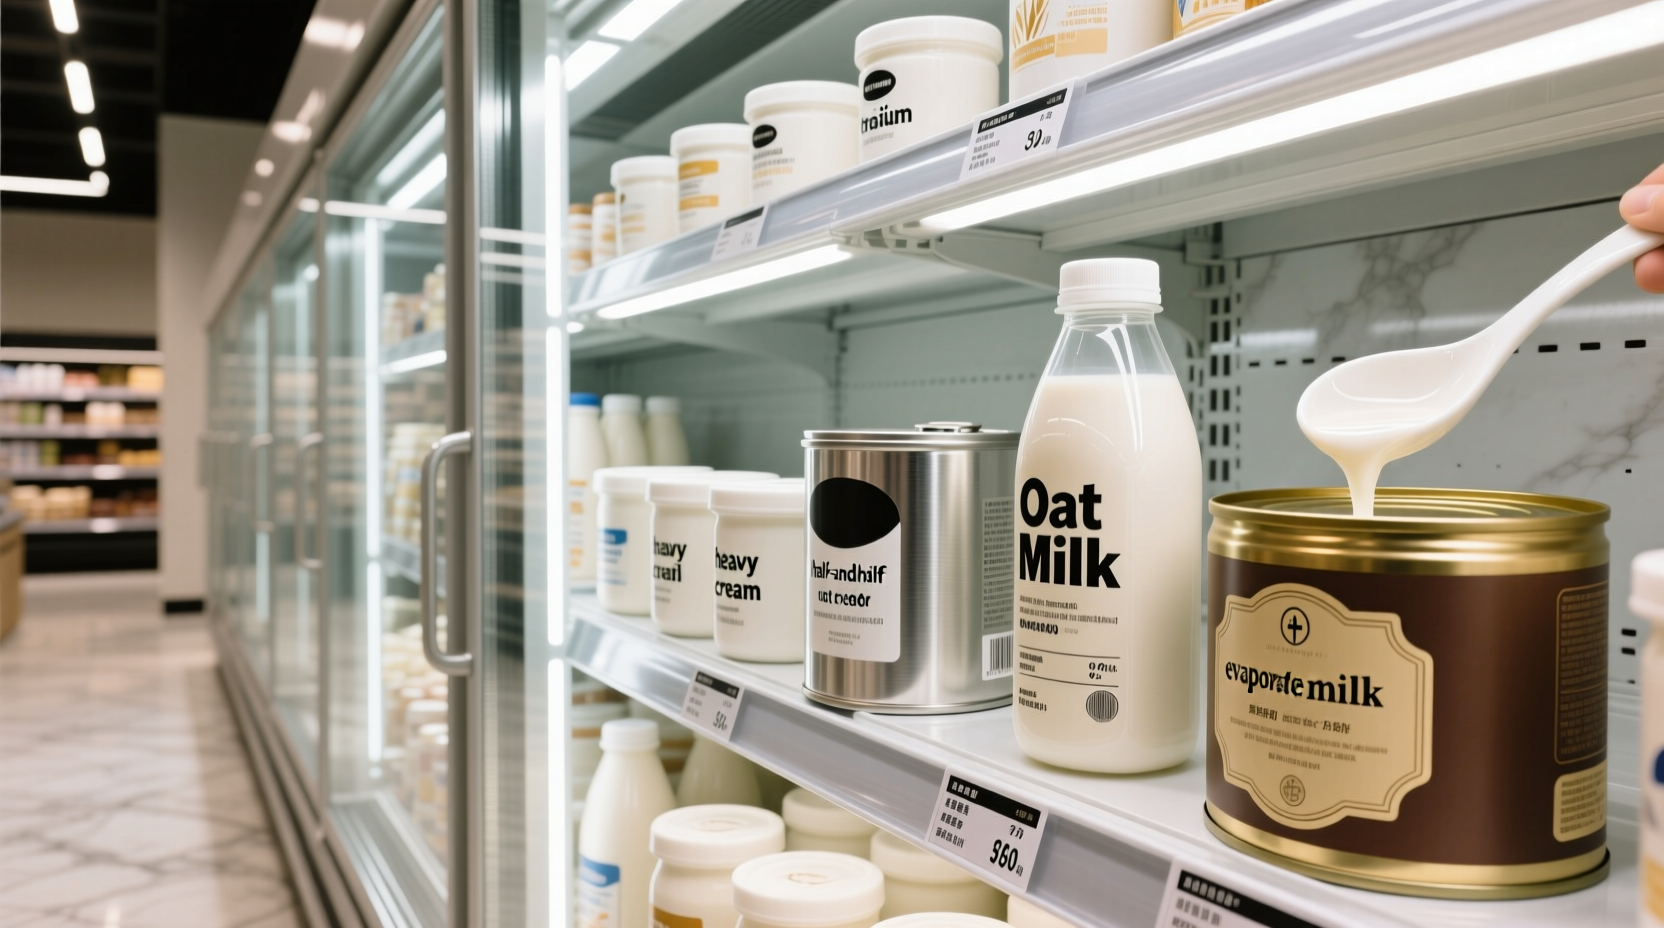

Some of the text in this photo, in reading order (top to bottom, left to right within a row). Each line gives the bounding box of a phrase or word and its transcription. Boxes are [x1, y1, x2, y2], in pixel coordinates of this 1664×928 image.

[1020, 477, 1102, 530] Oat
[715, 546, 759, 578] heavy
[1019, 532, 1121, 589] Milk
[715, 580, 761, 601] cream
[1306, 673, 1384, 708] milk
